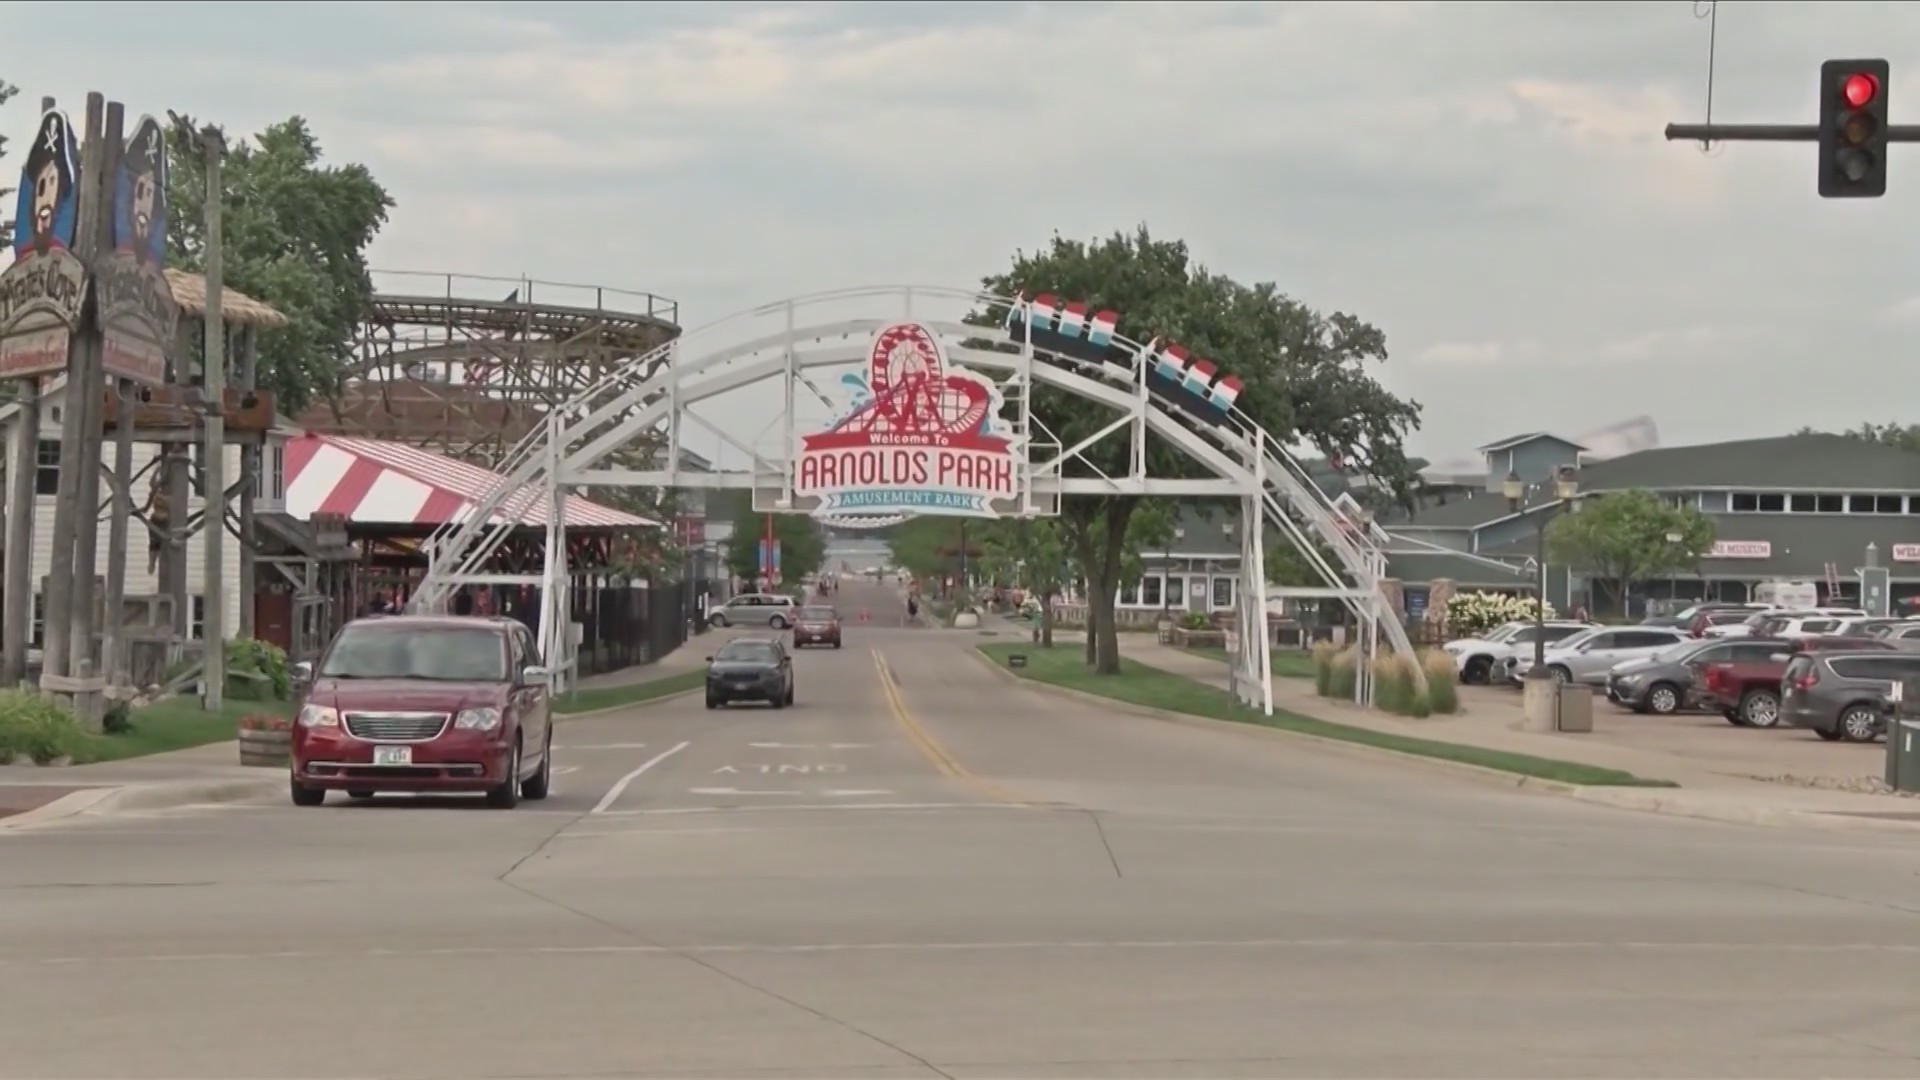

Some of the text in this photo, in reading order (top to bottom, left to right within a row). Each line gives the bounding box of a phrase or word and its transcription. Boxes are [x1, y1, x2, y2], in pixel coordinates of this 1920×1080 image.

[869, 433, 949, 446] Welcome To
[801, 451, 1012, 493] ARNOLDS PARK
[841, 490, 971, 507] AMUSEMENT PARK
[1727, 544, 1768, 554] MUSEUM
[1895, 547, 1920, 557] WEL
